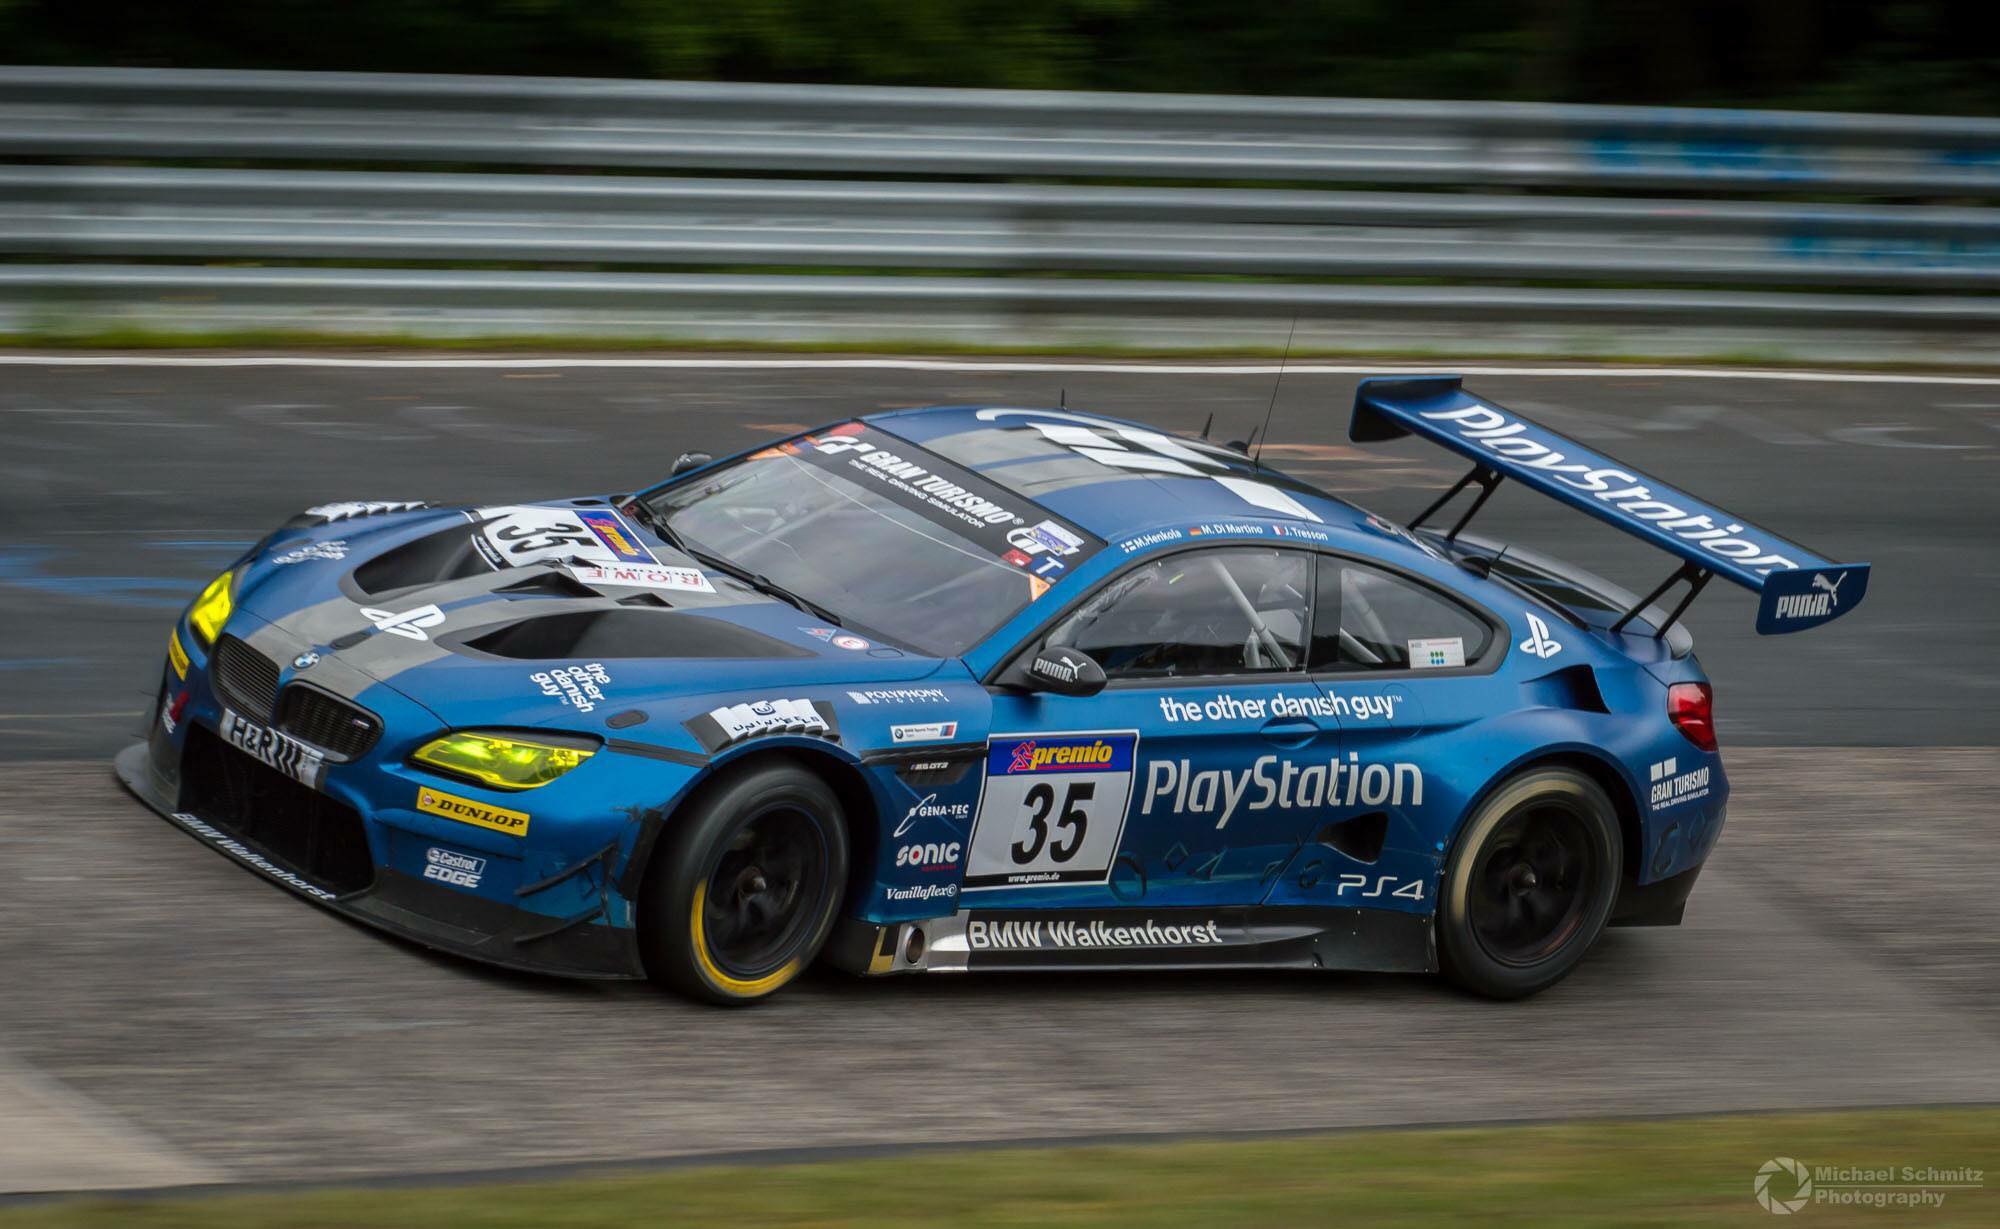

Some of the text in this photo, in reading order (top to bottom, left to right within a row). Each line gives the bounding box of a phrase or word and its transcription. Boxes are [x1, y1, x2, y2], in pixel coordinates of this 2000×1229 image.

[860, 450, 929, 480] GRAN
[888, 478, 928, 500] DRIVING
[927, 497, 985, 528] SIMULATOR
[1419, 405, 1800, 575] PlayStation
[497, 523, 599, 554] 35
[1226, 524, 1263, 535] Martino
[586, 568, 700, 586] ROWE
[567, 666, 605, 700] other
[585, 663, 611, 684] the
[550, 669, 595, 713] danish
[864, 688, 944, 698] POLYPHONY
[871, 696, 950, 704] DIGITAL
[1160, 696, 1202, 722] the
[1205, 695, 1266, 720] other
[1270, 691, 1350, 717] danish
[1029, 740, 1113, 770] premio
[1141, 752, 1423, 829] PlayStation
[1651, 766, 1709, 803] GRAN TURISMO
[438, 799, 525, 828] DUNLOP
[919, 804, 969, 817] GENA-TEC
[1011, 782, 1096, 865] 35
[171, 813, 337, 901] BMW Walkenhorst
[440, 852, 478, 871] Castrol
[424, 864, 482, 888] EDGE
[1008, 872, 1060, 884] www.premio.de
[1337, 874, 1424, 900] PS4
[968, 919, 1223, 949] BMW Walkenhorst
